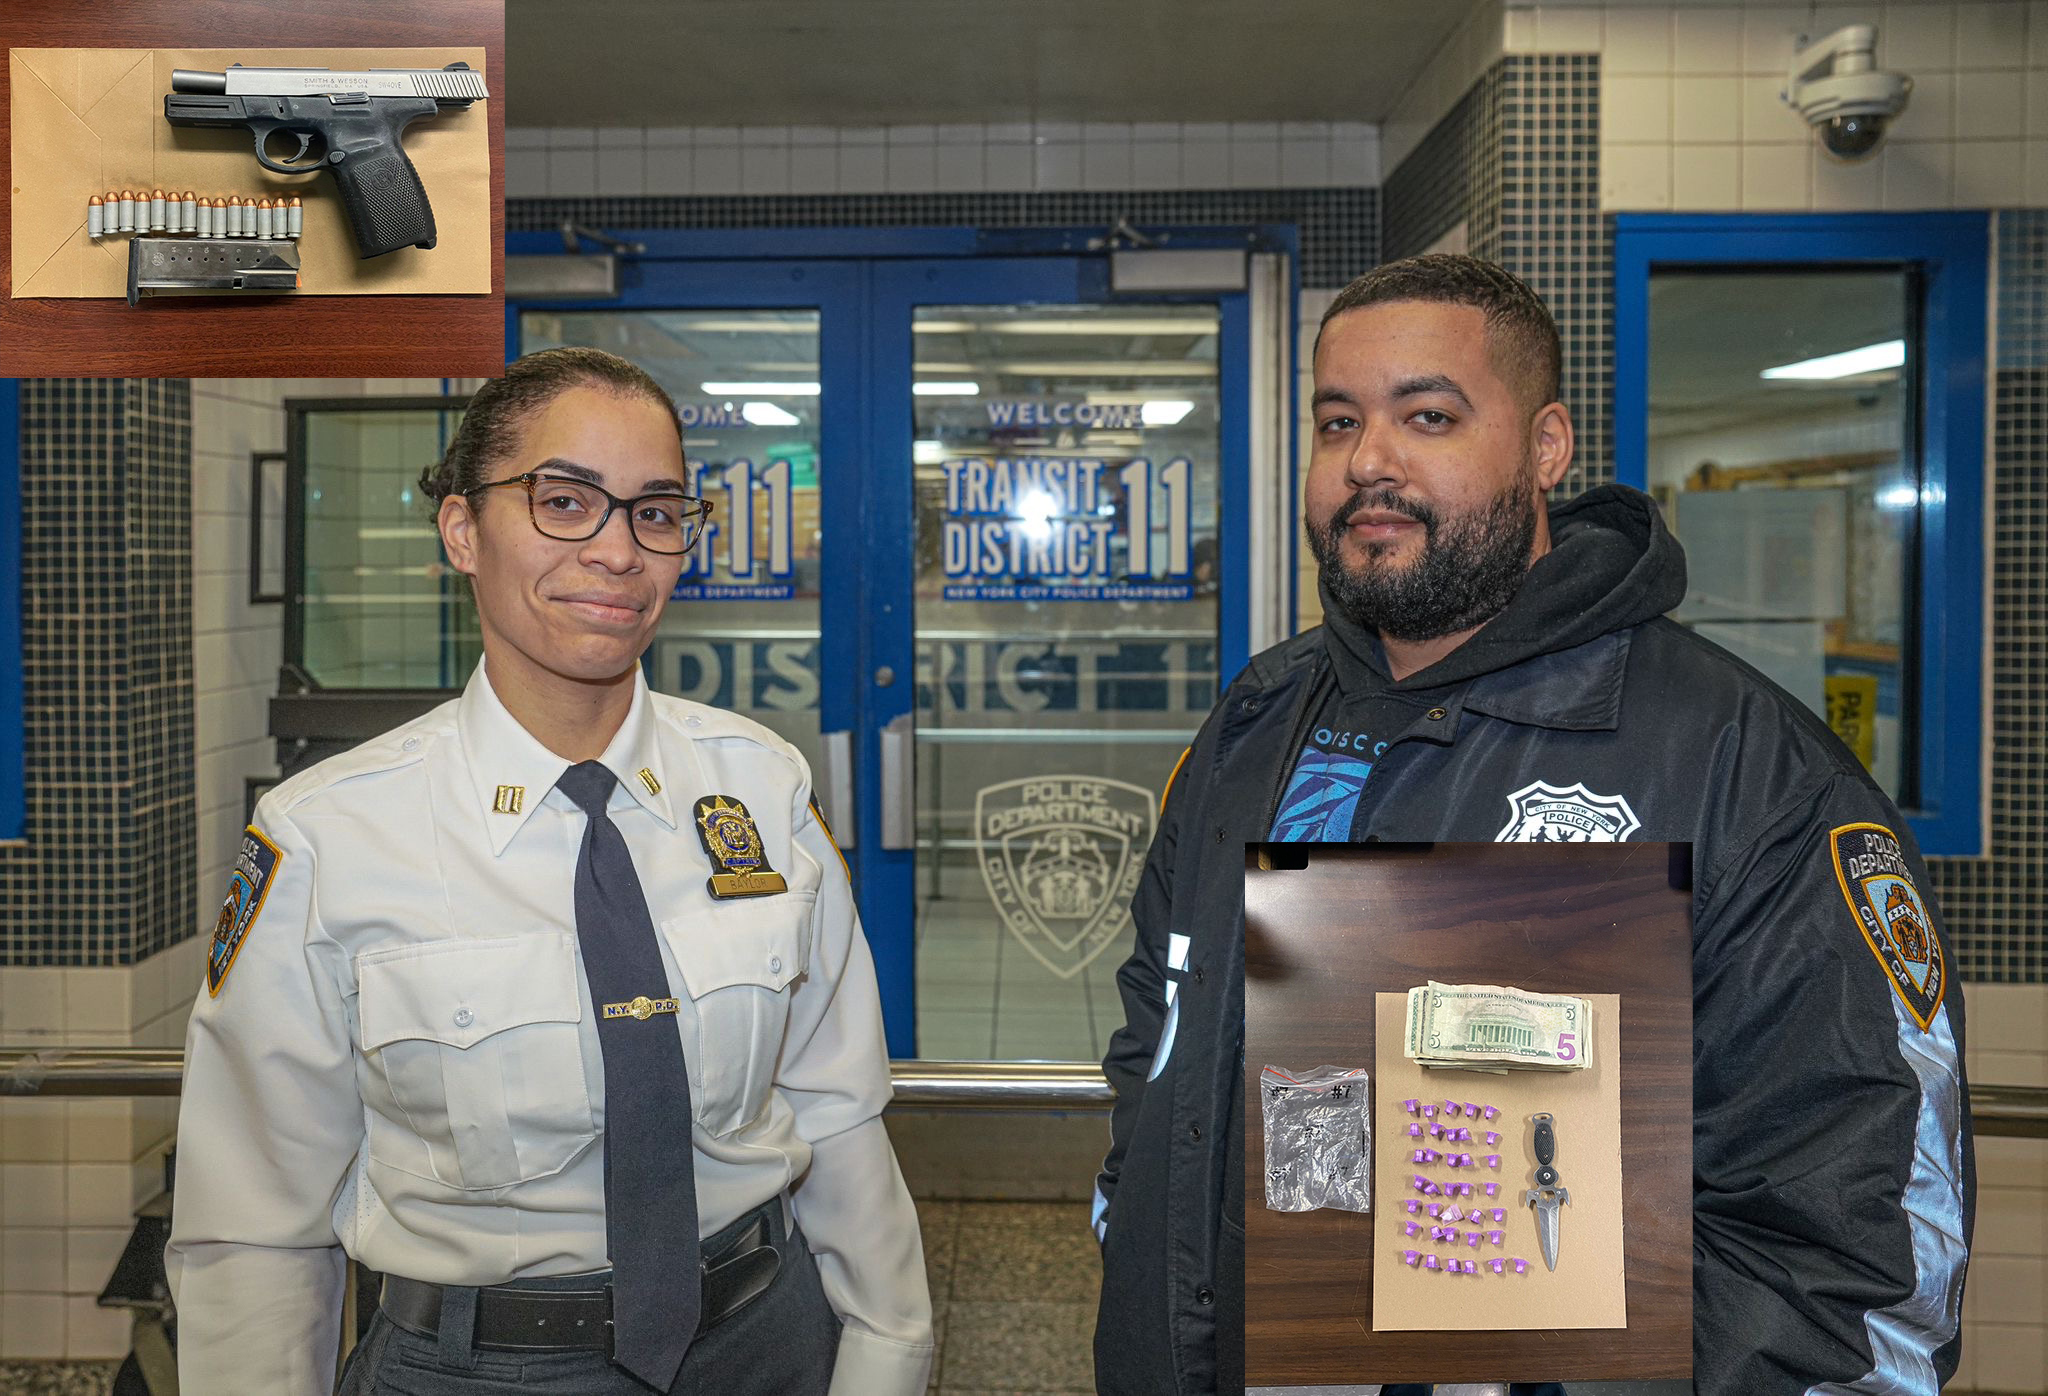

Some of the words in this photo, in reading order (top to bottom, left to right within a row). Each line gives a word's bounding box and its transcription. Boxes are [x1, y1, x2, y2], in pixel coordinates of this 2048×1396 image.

[987, 402, 1143, 426] WELCOME
[943, 460, 1102, 513] TRANSIT
[724, 460, 790, 574] 11
[1120, 460, 1189, 574] 11
[944, 521, 1114, 575] DISTRICT
[706, 586, 789, 598] DEPARTMENT
[946, 587, 977, 599] NEW
[981, 587, 1016, 599] YORK
[1020, 587, 1049, 599] CITY
[1053, 587, 1098, 599] POLICE
[1103, 587, 1188, 599] DEPARTMENT
[1022, 782, 1110, 804] POLICE
[987, 803, 1144, 837] DEPARTMENT
[1535, 803, 1553, 812] CITY
[1570, 805, 1588, 816] NEW
[1591, 812, 1612, 829] YORK
[1549, 812, 1591, 829] POLICE
[729, 878, 769, 890] BAYLOR
[987, 856, 1016, 904] CITY
[1088, 902, 1123, 945] NEW
[232, 899, 258, 945] YORK
[1859, 905, 1893, 952] CITY
[1891, 959, 1911, 987] OF
[1925, 963, 1940, 1002] NEW
[1433, 993, 1443, 1008] 5
[1565, 1005, 1576, 1021] 5
[1429, 1031, 1441, 1049] 5
[1556, 1033, 1576, 1061] 5
[1331, 1085, 1352, 1099] #7
